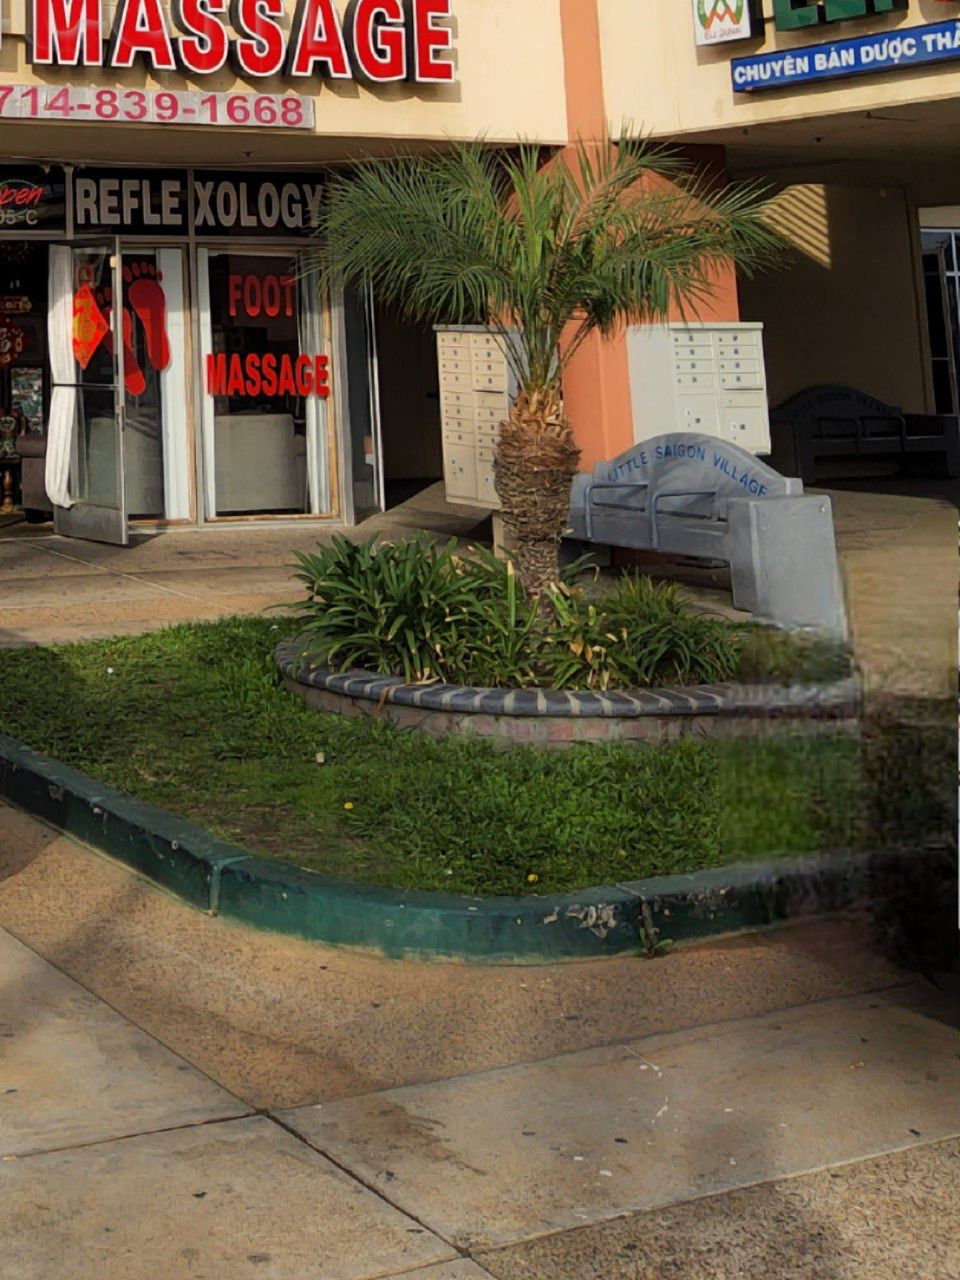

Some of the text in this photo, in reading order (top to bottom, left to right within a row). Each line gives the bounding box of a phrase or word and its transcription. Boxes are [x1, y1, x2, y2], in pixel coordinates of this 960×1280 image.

[734, 52, 809, 85] CHUYÊN
[860, 36, 917, 65] DƯỢC
[228, 273, 297, 317] FOOT
[206, 353, 331, 397] MASSAGE
[607, 444, 770, 497] LITTLE SAIGON VILLAGE
